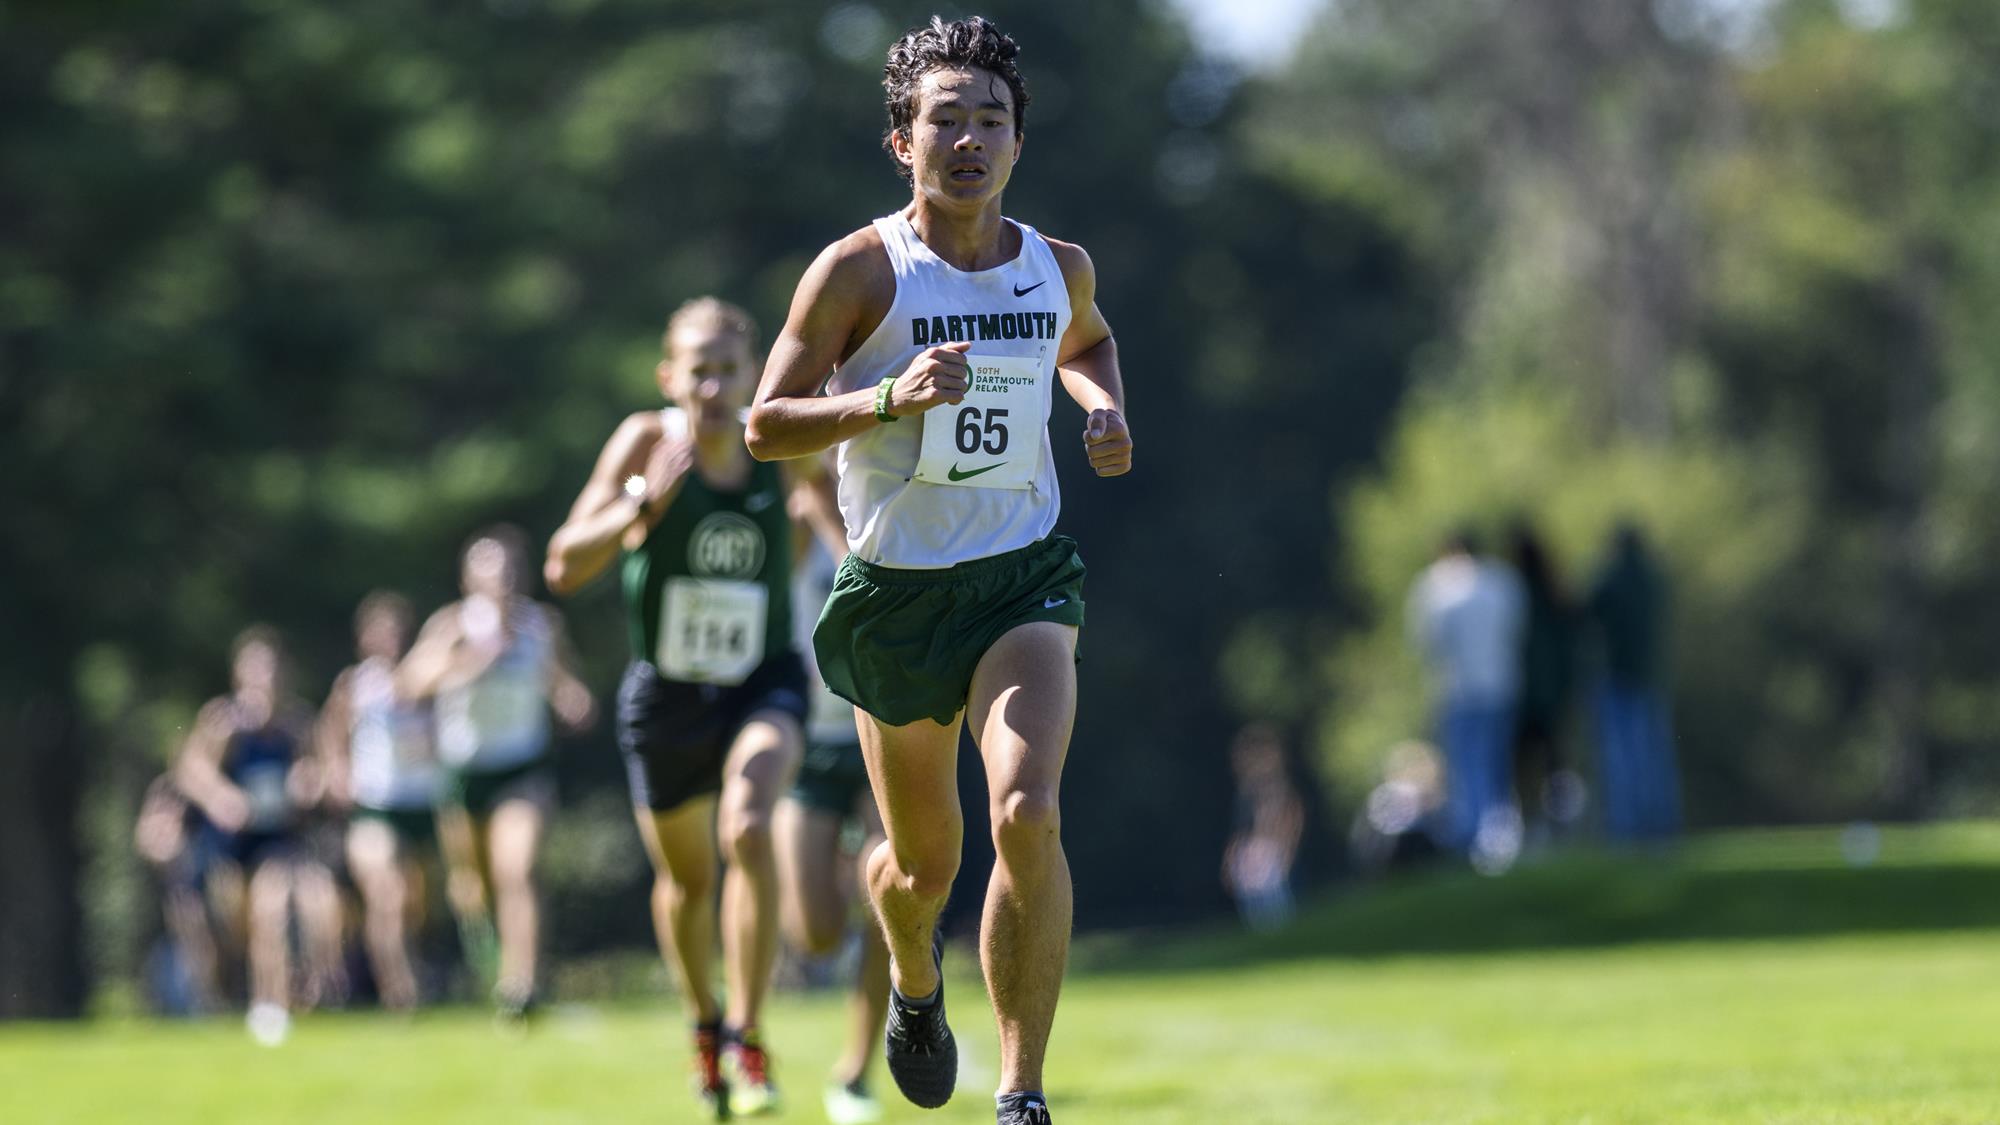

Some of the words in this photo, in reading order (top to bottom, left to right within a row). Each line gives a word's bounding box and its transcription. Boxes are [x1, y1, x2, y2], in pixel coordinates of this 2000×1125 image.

[912, 312, 1057, 346] DARTMOUTH
[976, 367, 1000, 375] 50TH
[976, 375, 1035, 386] DARTMOUTH
[975, 384, 1009, 393] RELAYS
[955, 406, 1009, 456] 65
